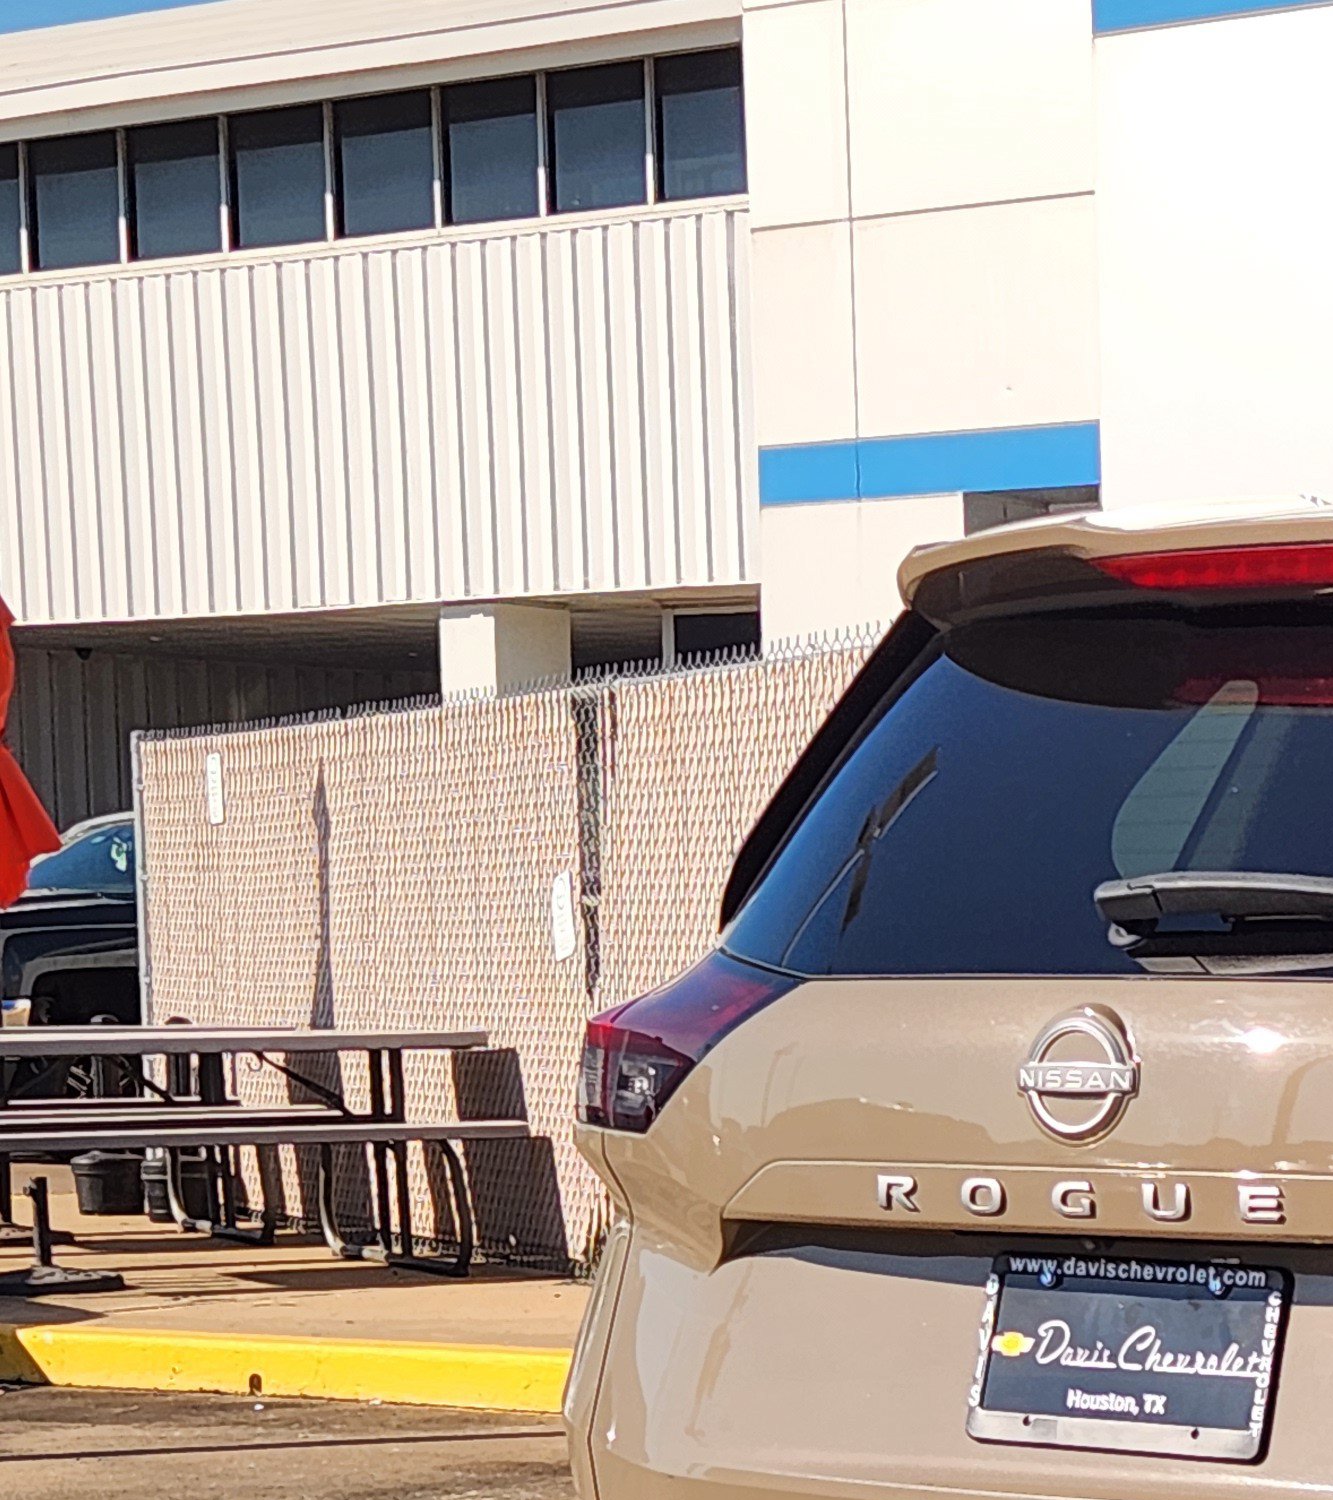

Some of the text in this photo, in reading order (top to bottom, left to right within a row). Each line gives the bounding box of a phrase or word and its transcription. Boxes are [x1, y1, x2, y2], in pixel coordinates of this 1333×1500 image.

[1019, 1067, 1133, 1091] NISSAN
[877, 1174, 1287, 1221] ROGUE
[1009, 1256, 1266, 1287] www.davischevrolet.com
[968, 1273, 999, 1407] DAVIS
[1035, 1319, 1262, 1377] Davis Chevrolet
[1249, 1291, 1282, 1437] CHEVROLET
[1066, 1389, 1167, 1416] Houston, TX
